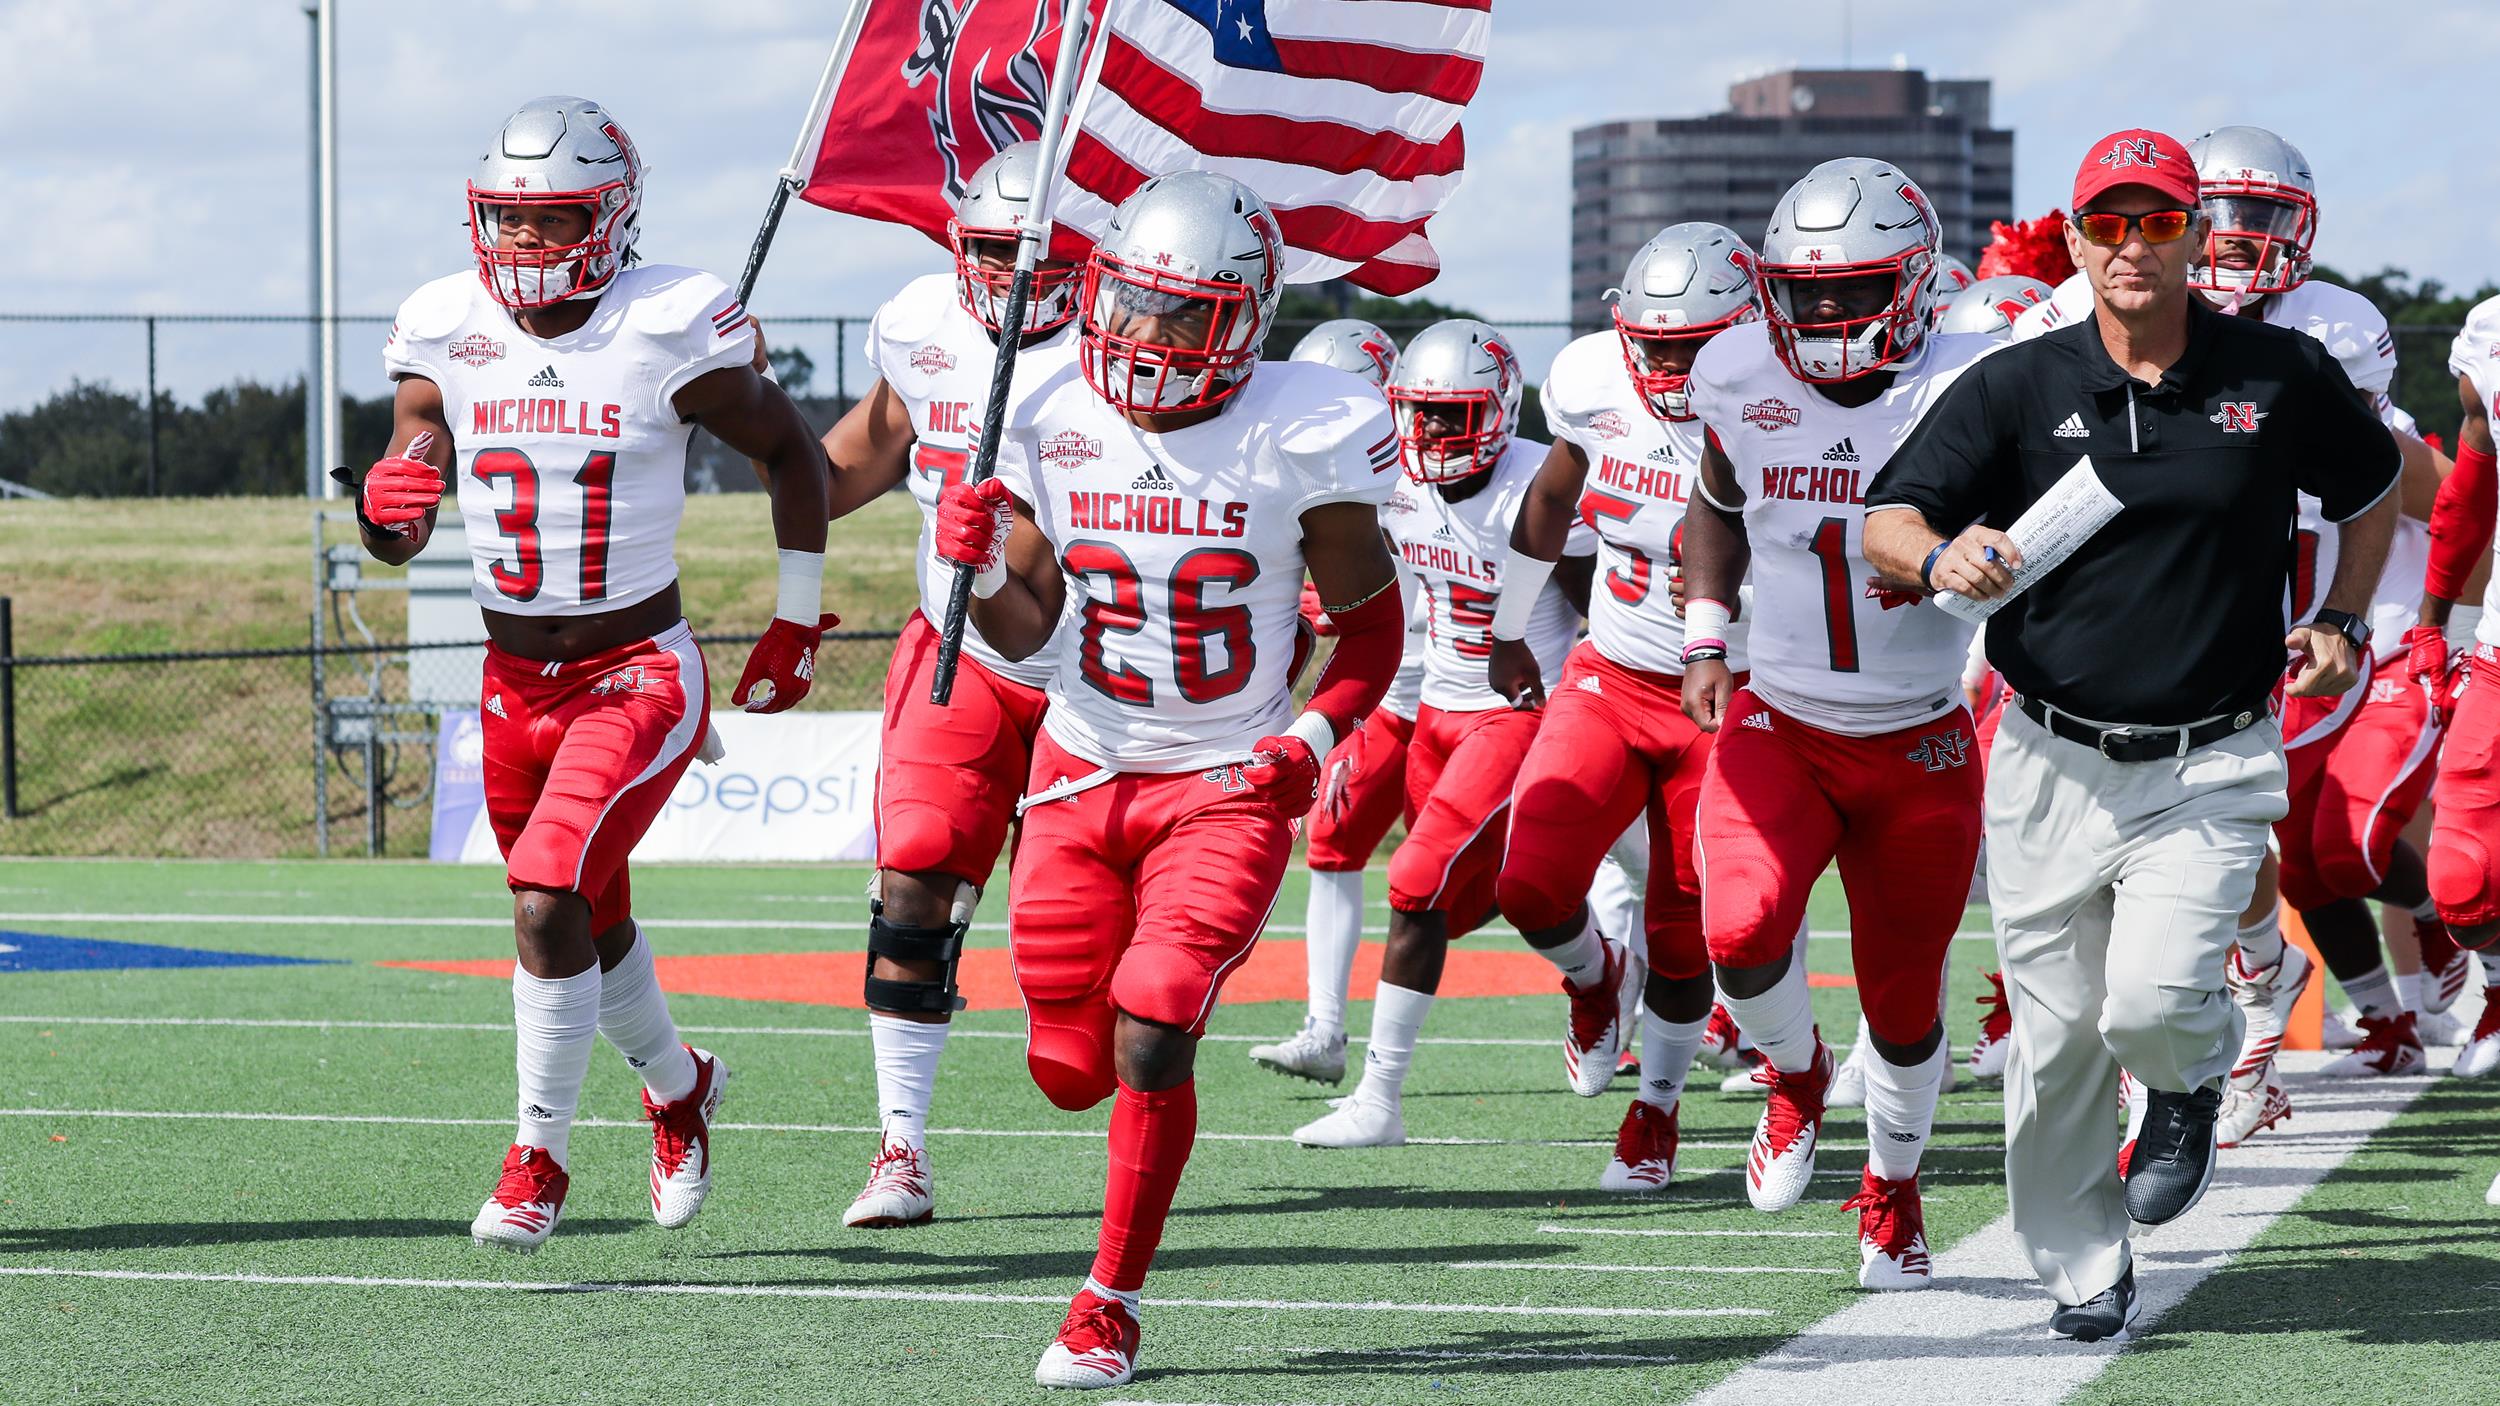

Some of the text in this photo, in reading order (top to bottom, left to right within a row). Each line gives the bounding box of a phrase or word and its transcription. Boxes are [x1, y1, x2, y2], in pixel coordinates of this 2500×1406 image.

[2113, 138, 2156, 170] N
[514, 177, 527, 188] N
[1157, 252, 1172, 266] N
[1809, 249, 1822, 261] N
[449, 342, 505, 359] SOUTHLAND
[911, 351, 956, 369] SOUTHLAND
[528, 378, 564, 388] adidas
[472, 398, 621, 438] NICHOLLS
[928, 401, 973, 433] NIC
[1743, 404, 1800, 426] SOUTHLAND
[2220, 402, 2258, 433] N
[2053, 427, 2090, 438] adidas
[1039, 440, 1102, 460] SOUTHLAND
[1647, 453, 1680, 466] adidas
[1822, 451, 1860, 462] adidas
[1132, 479, 1174, 491] adidas
[1598, 454, 1688, 503] NICHOL
[1762, 466, 1866, 505] NICHOL
[471, 448, 617, 605] 31
[1068, 491, 1249, 538] NICHOLLS
[2022, 504, 2069, 547] STONEWALLERS
[2041, 532, 2070, 559] BOMBERS
[1400, 541, 1497, 584] NICHOLLS
[1808, 516, 1859, 673] 1
[1060, 538, 1260, 707] 26
[1414, 572, 1499, 661] 15
[604, 665, 645, 695] N
[1741, 718, 1775, 732] adidas
[1924, 729, 1968, 773] N
[665, 765, 859, 825] pepsi
